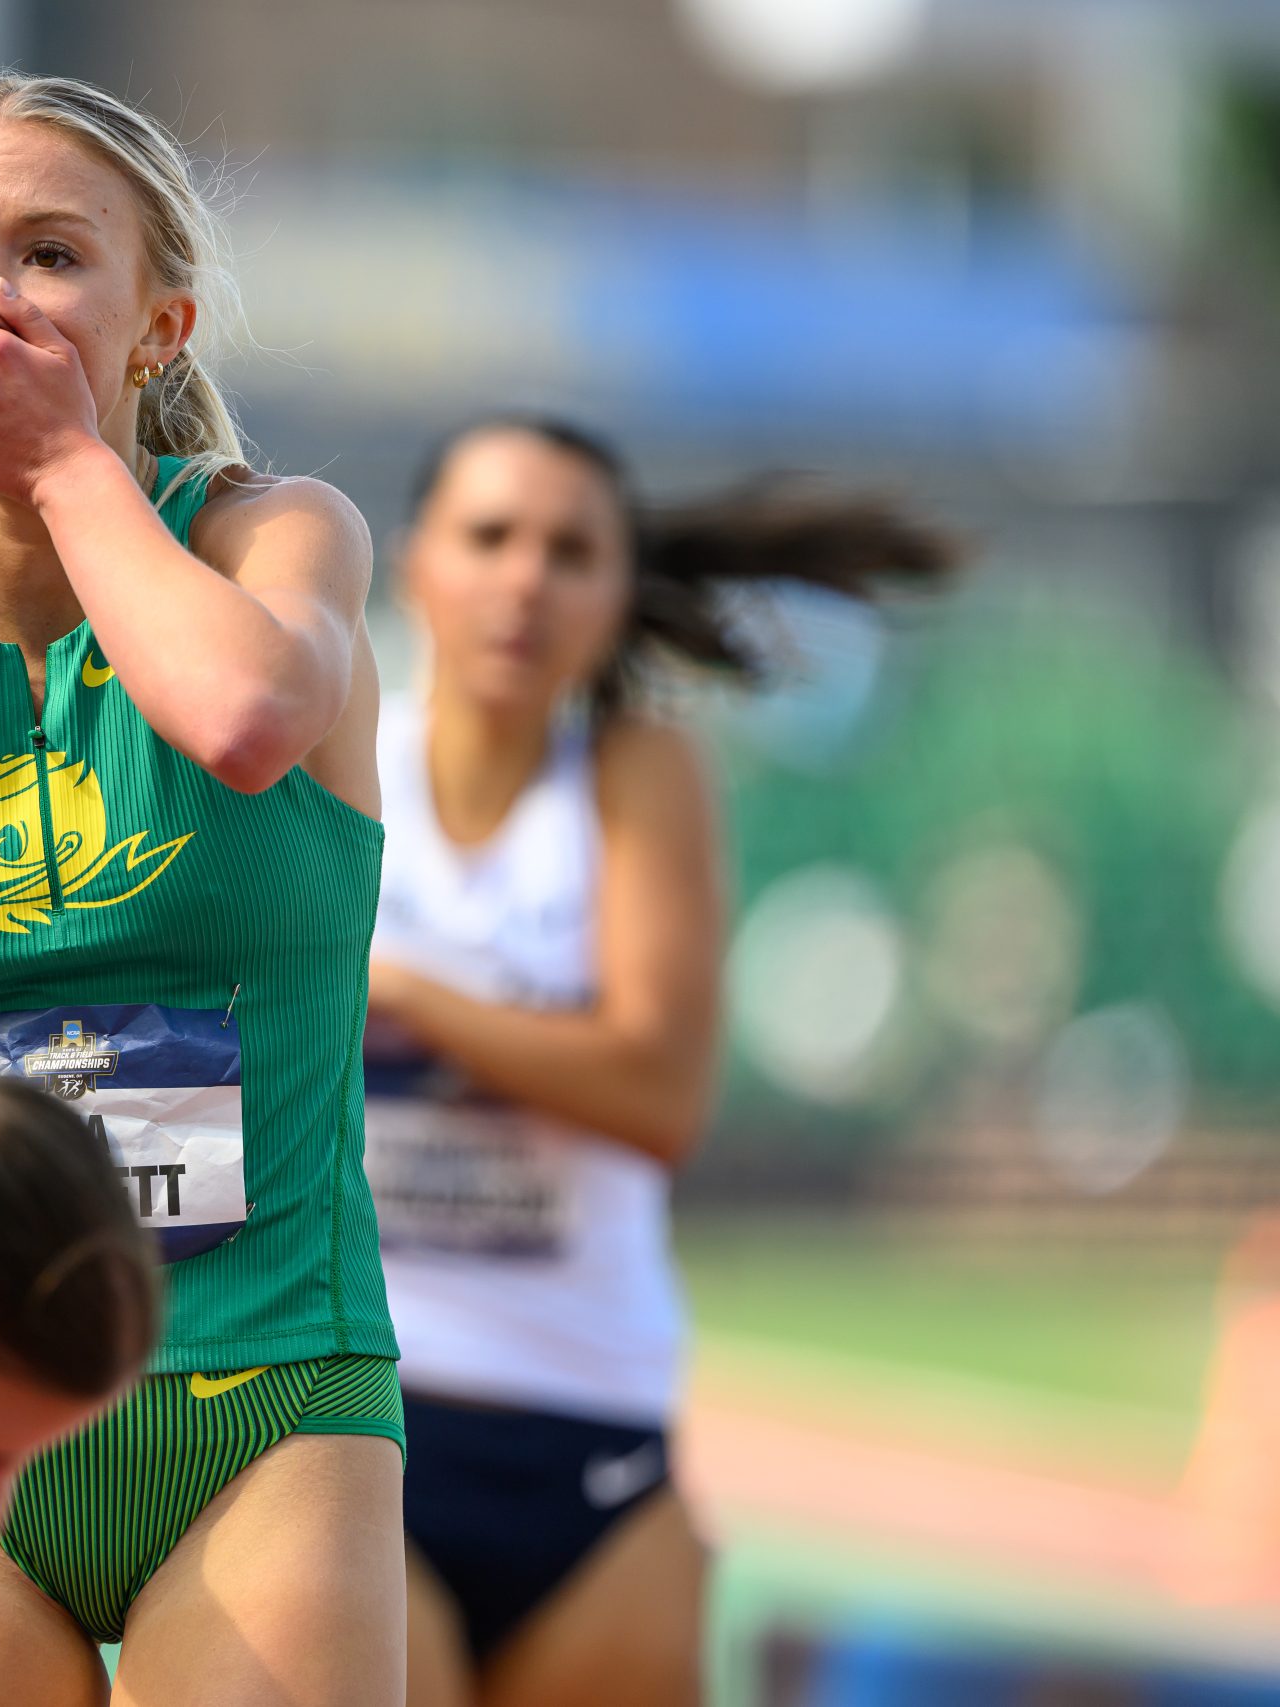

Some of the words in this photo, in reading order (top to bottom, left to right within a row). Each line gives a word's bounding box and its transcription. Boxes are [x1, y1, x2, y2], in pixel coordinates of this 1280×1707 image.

[49, 1052, 69, 1060] TRACK
[76, 1050, 94, 1058] FIELD
[32, 1057, 110, 1071] CHAMPIONSHIPS
